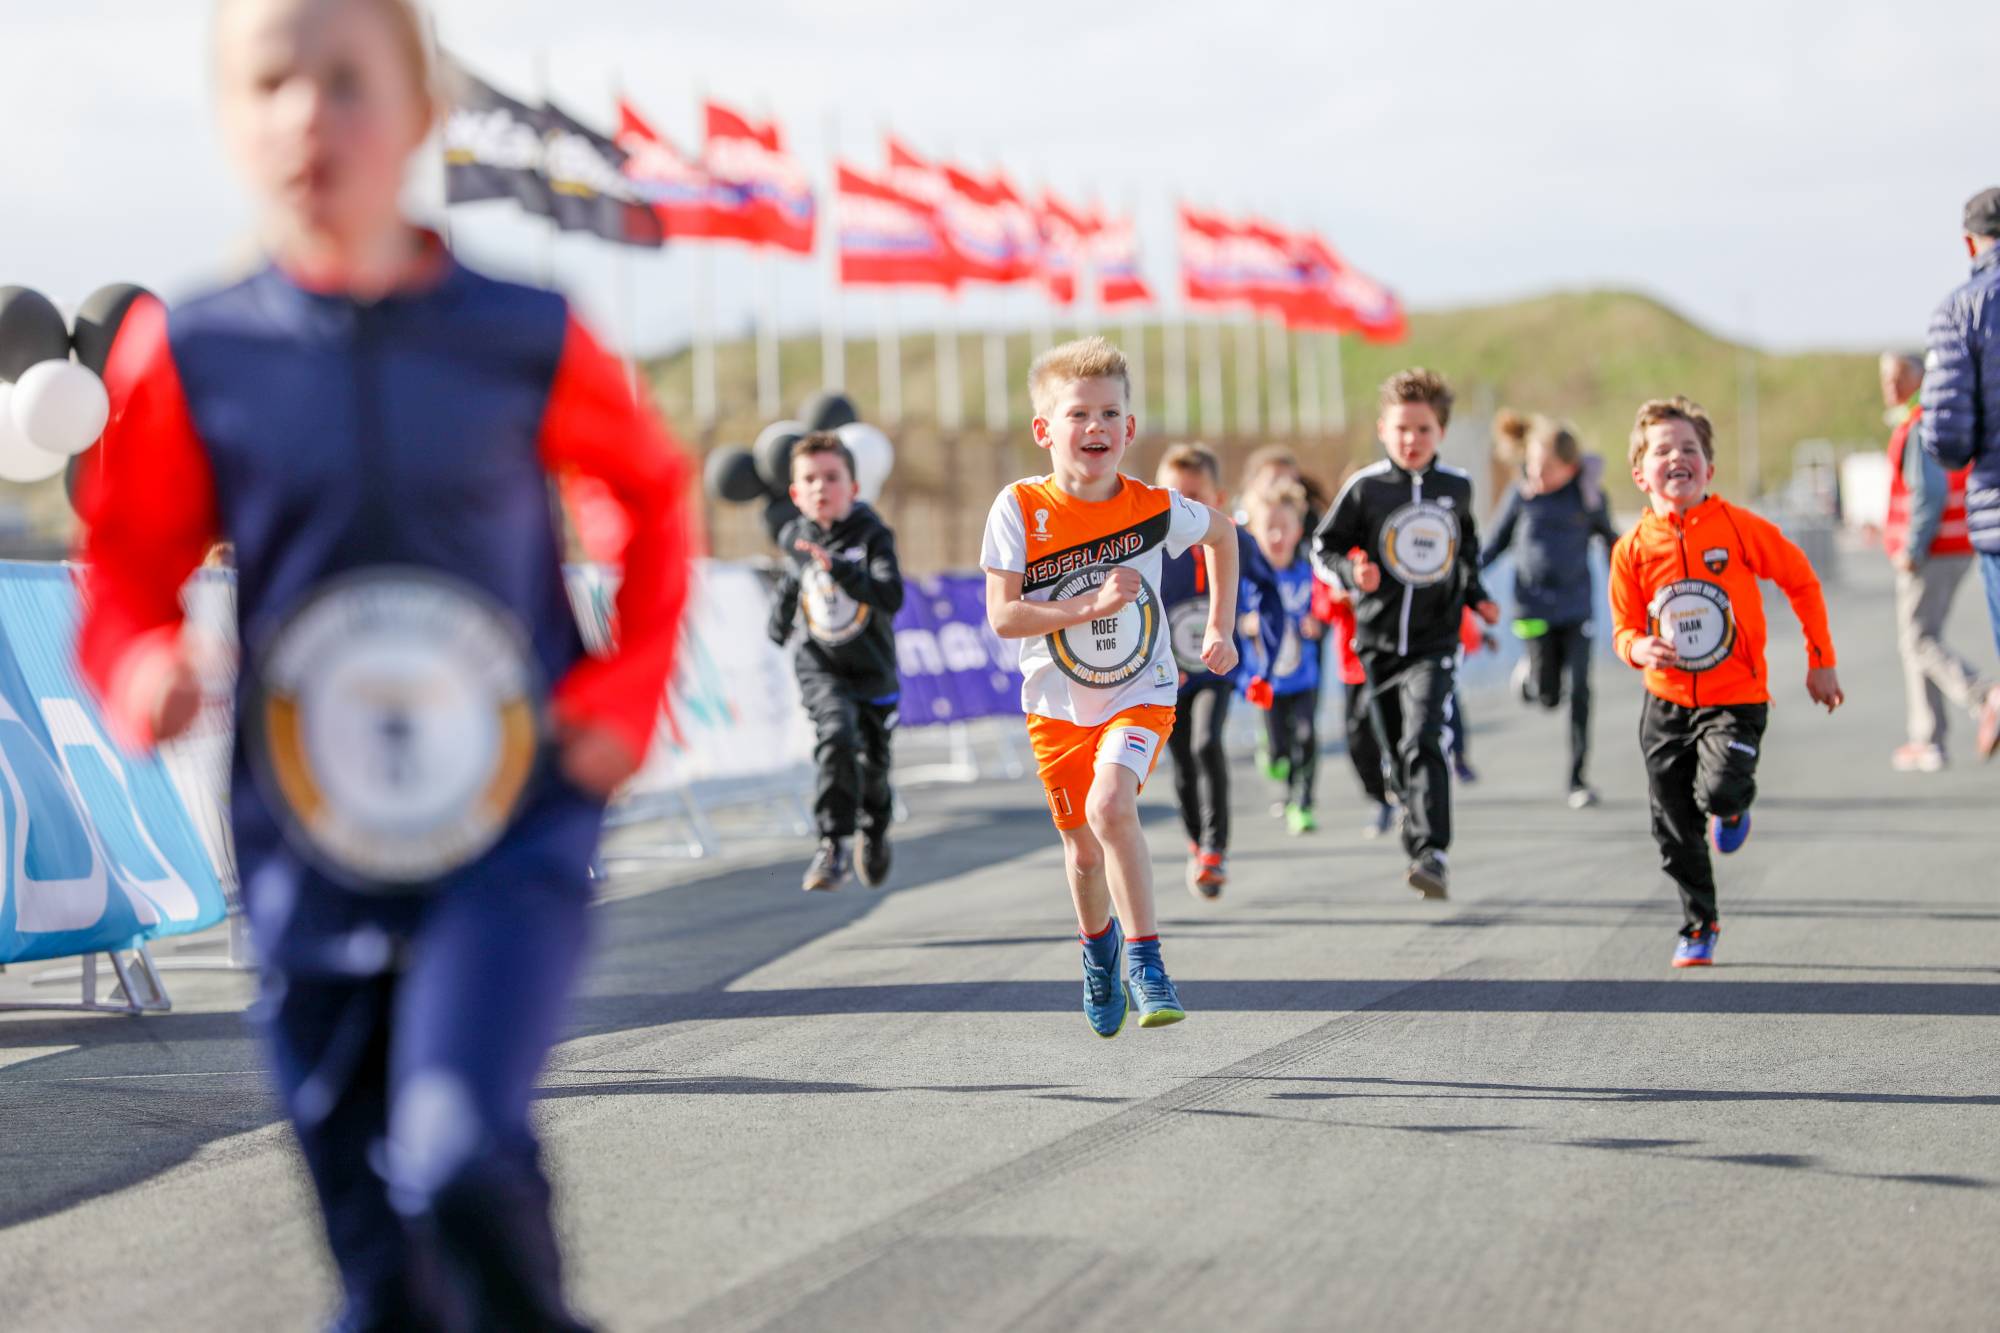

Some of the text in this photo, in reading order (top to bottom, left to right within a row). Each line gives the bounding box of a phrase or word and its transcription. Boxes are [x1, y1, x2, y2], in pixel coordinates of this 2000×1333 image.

[1024, 533, 1143, 586] NEDERLAND
[1091, 617, 1119, 636] ROEF
[1096, 637, 1117, 651] K106
[1072, 655, 1146, 684] KIDS CIRCUIT RUN
